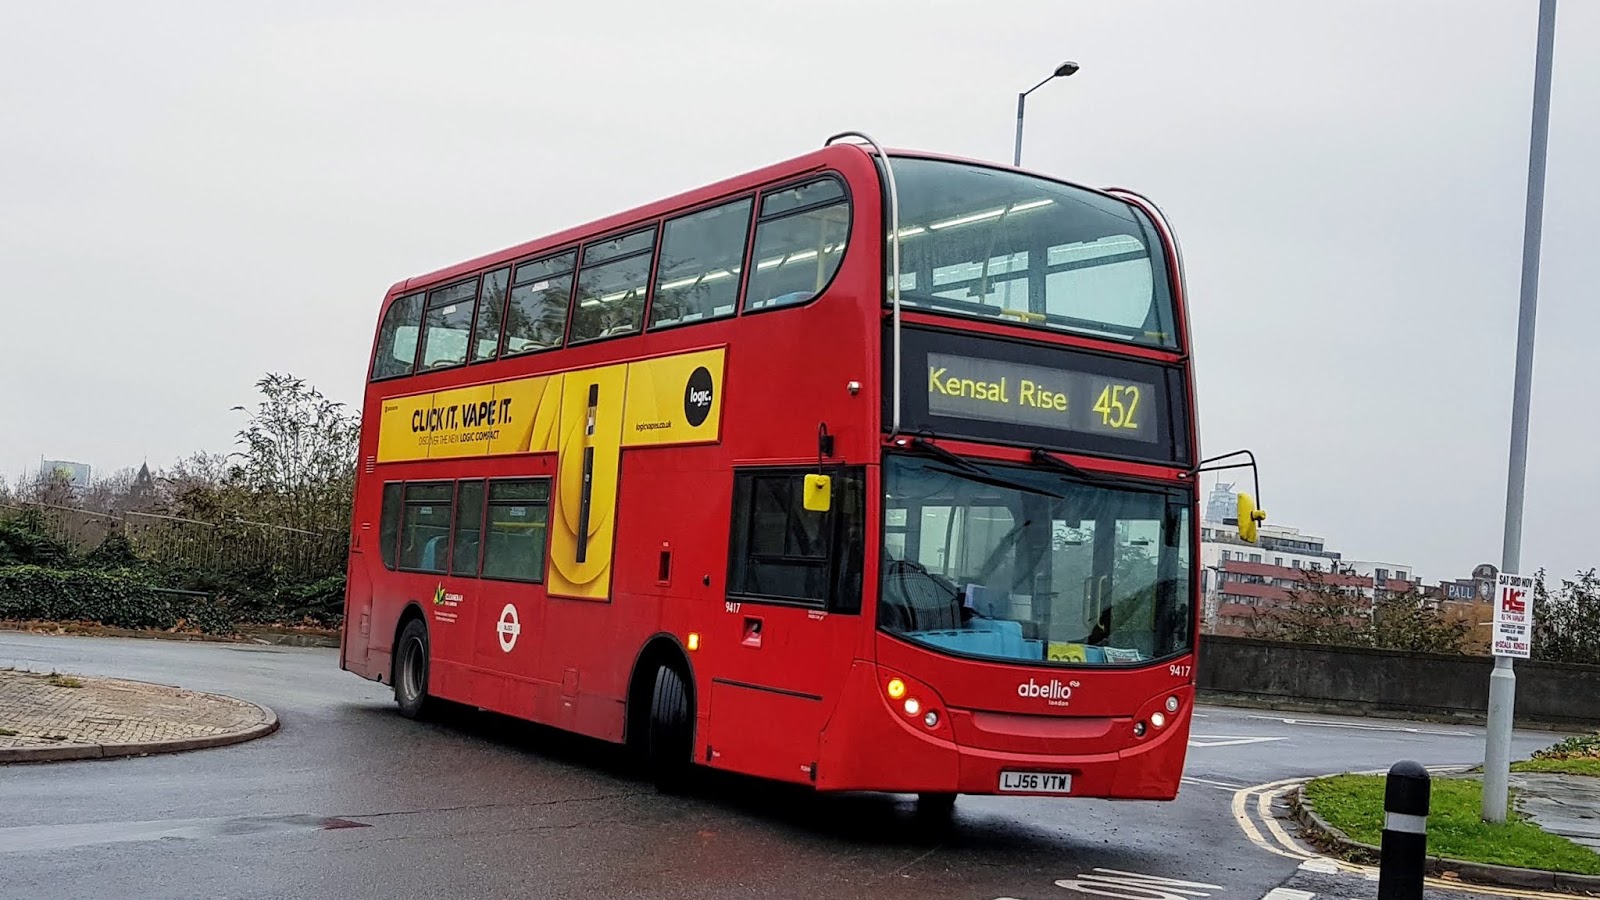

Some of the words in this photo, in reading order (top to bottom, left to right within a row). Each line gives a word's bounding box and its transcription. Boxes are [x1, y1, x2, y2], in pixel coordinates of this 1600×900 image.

[928, 366, 1009, 404] Kensal
[1019, 379, 1068, 412] Rise
[1092, 384, 1141, 430] 452
[411, 406, 446, 433] CLICK
[445, 404, 459, 431] IT,
[462, 400, 497, 428] VAPE
[498, 398, 512, 424] IT.
[460, 432, 475, 443] LOGIC
[475, 430, 500, 442] COMPACT
[1499, 575, 1509, 586] SAT
[1522, 577, 1534, 588] NOV
[1448, 584, 1473, 599] PALL
[725, 601, 741, 614] 9417
[1169, 664, 1191, 677] 9417
[1017, 678, 1071, 699] abellio
[1004, 774, 1039, 789] LJ56
[1042, 775, 1067, 790] VTW
